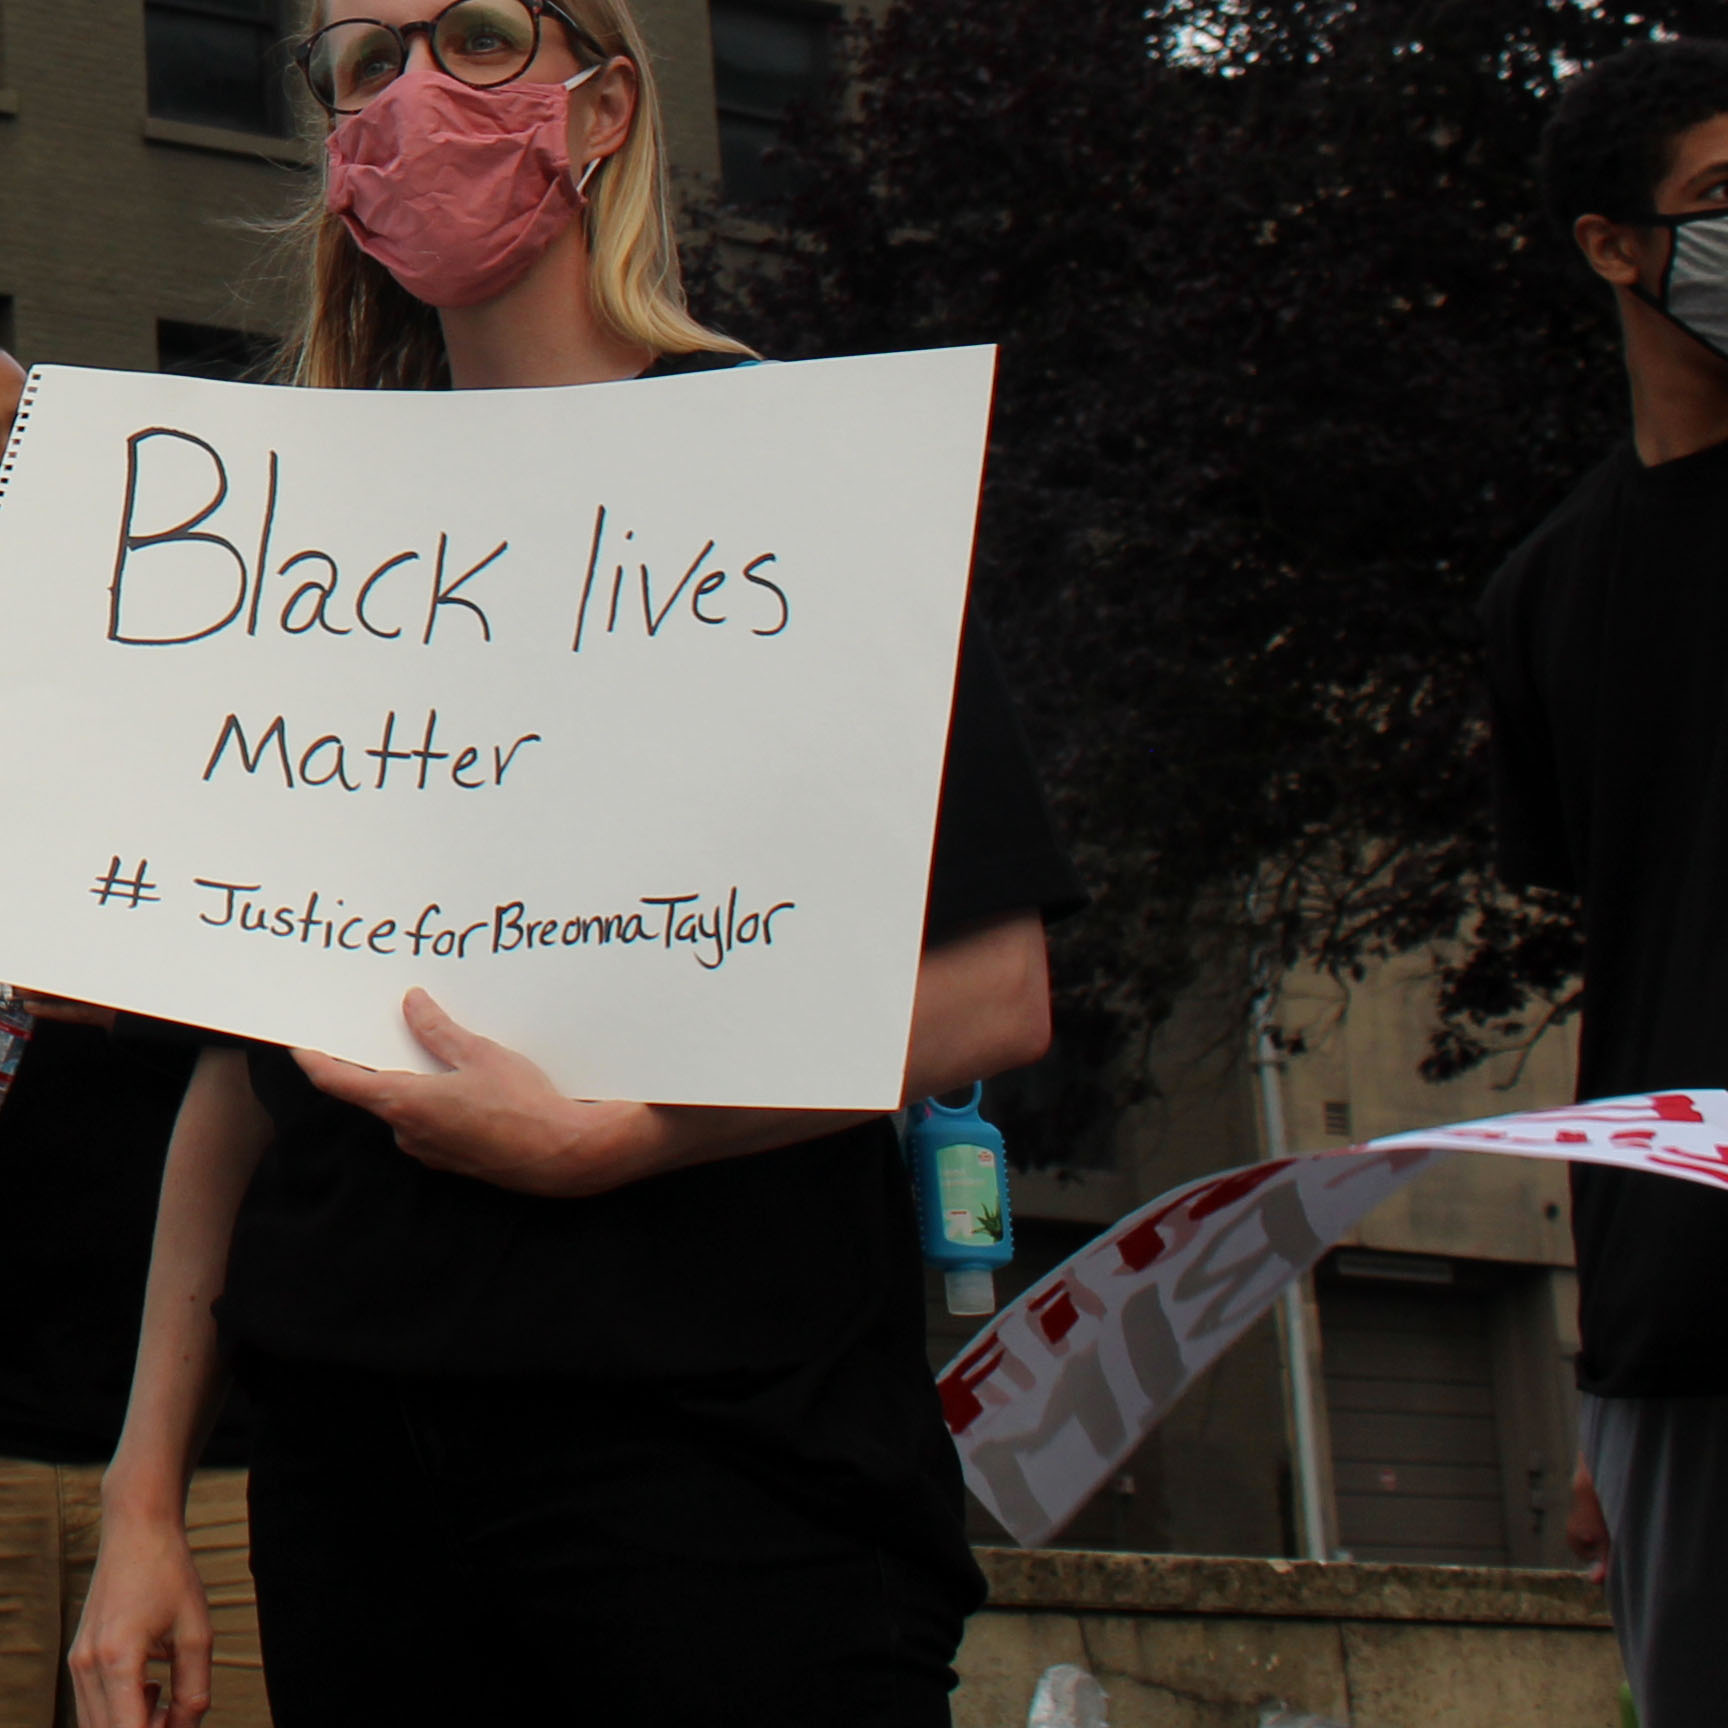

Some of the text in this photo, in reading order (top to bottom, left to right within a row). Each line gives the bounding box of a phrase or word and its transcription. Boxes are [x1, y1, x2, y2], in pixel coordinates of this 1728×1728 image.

[108, 426, 790, 653] Black lives
[202, 710, 543, 794] Matter
